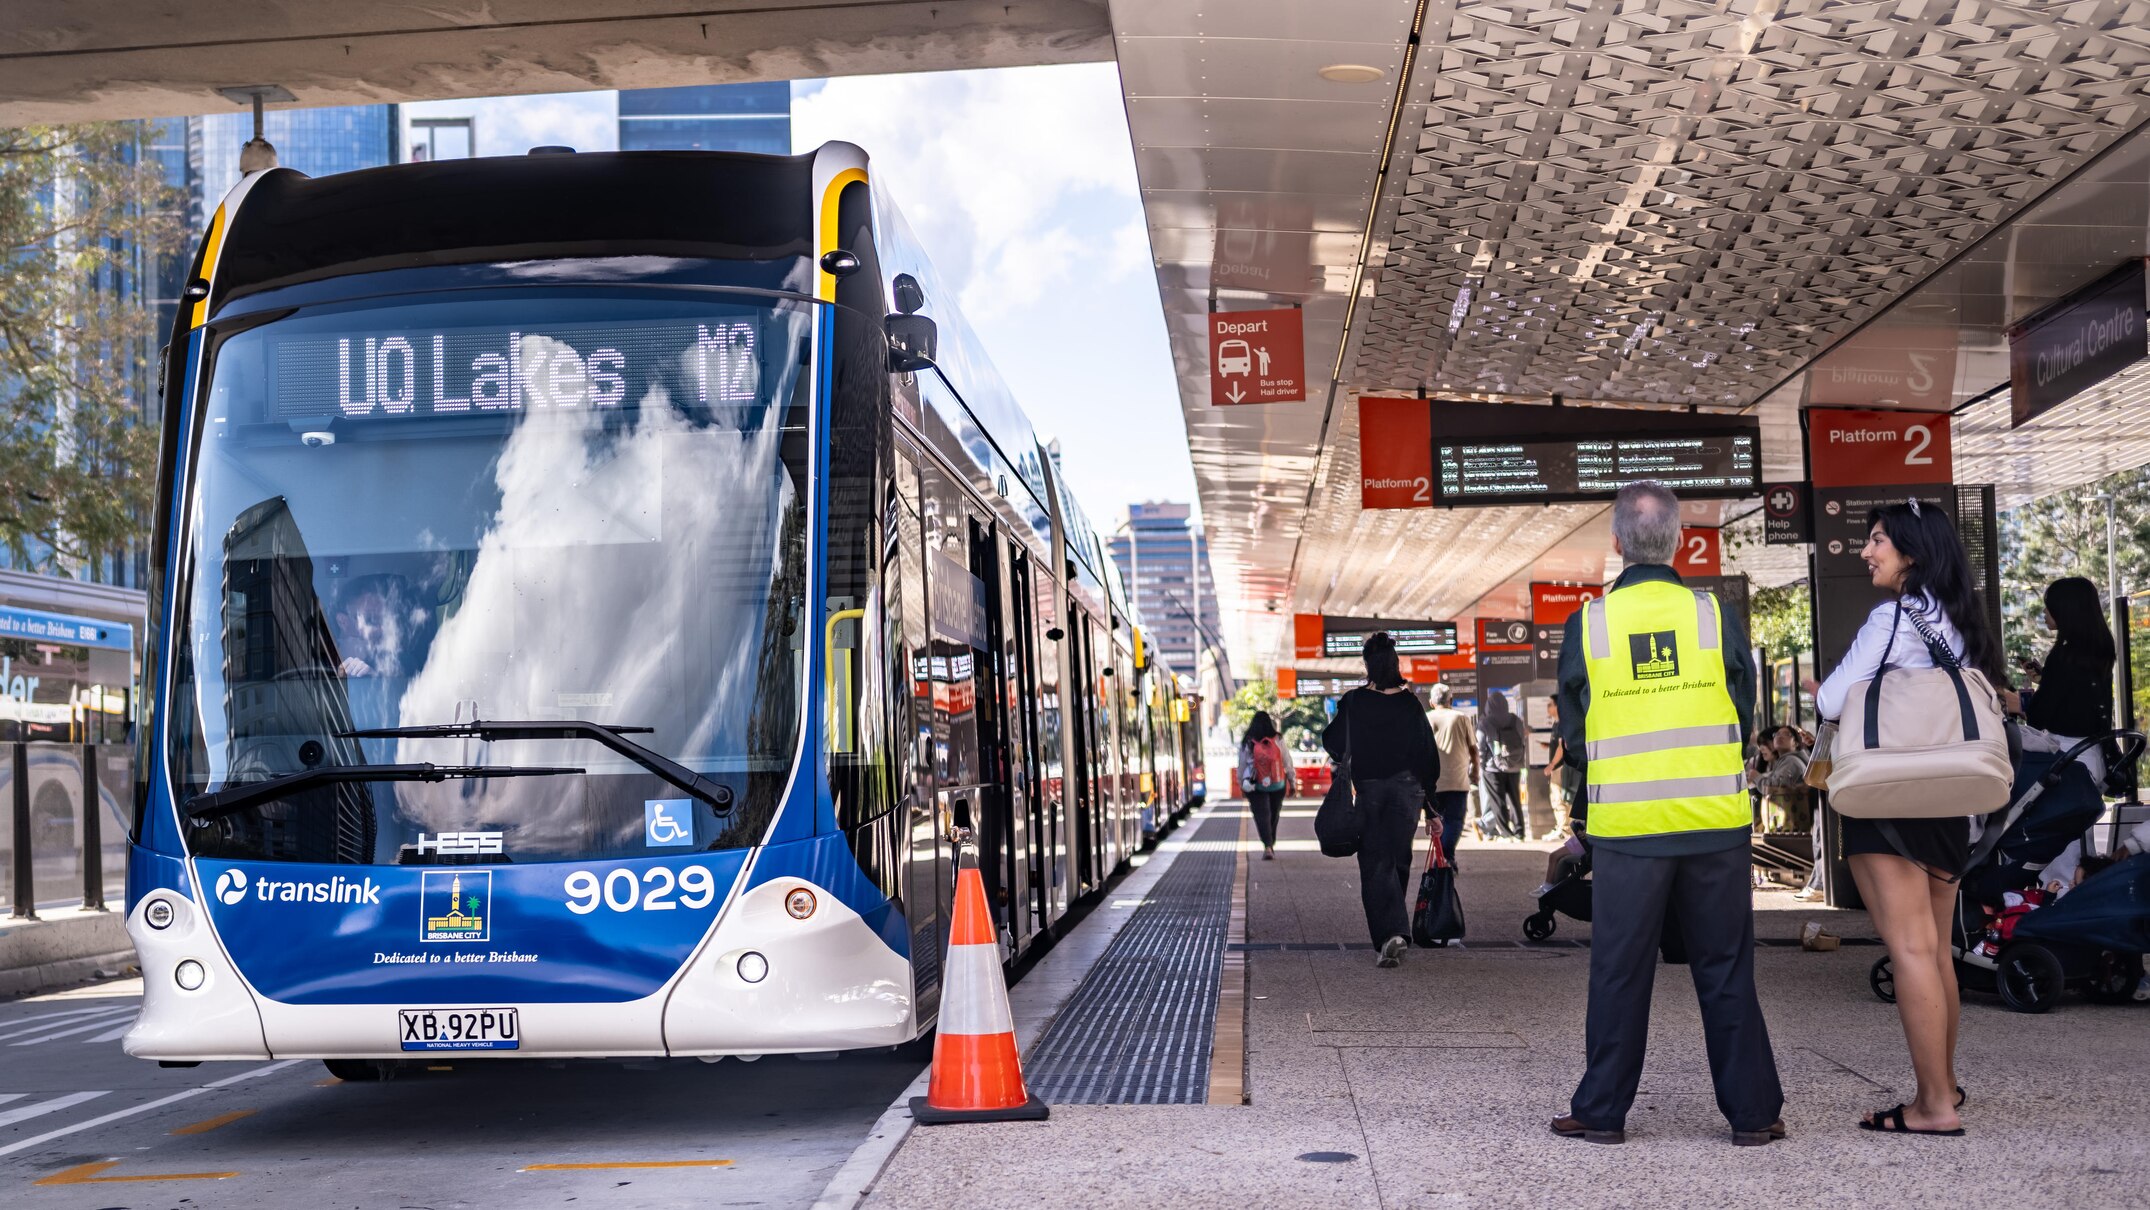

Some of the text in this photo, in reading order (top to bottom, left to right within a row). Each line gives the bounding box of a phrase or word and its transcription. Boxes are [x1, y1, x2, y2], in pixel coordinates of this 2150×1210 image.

[1217, 320, 1268, 335] Depart
[2037, 307, 2133, 387] Cultural Centre
[339, 322, 755, 414] UQ Lakes M2
[1260, 379, 1293, 387] Bus stop
[1830, 424, 1933, 465] Platform 2
[1364, 478, 1412, 489] Platform
[1413, 477, 1430, 501] 2
[1768, 519, 1790, 531] Help
[1768, 531, 1799, 542] phone
[1848, 538, 1864, 546] This
[1688, 536, 1708, 565] 2
[1542, 594, 1577, 602] Platform
[28, 618, 46, 634] better
[47, 621, 75, 638] Brisbane
[1637, 672, 1662, 680] BRISBANE
[1602, 686, 1640, 698] Dedicated
[1642, 687, 1650, 695] to
[1659, 682, 1680, 692] better
[1682, 680, 1716, 690] Brisbane
[418, 831, 503, 855] HESS
[256, 875, 380, 904] translink
[564, 865, 715, 915] 9029
[373, 951, 538, 964] Dedicated to a better Brisbane
